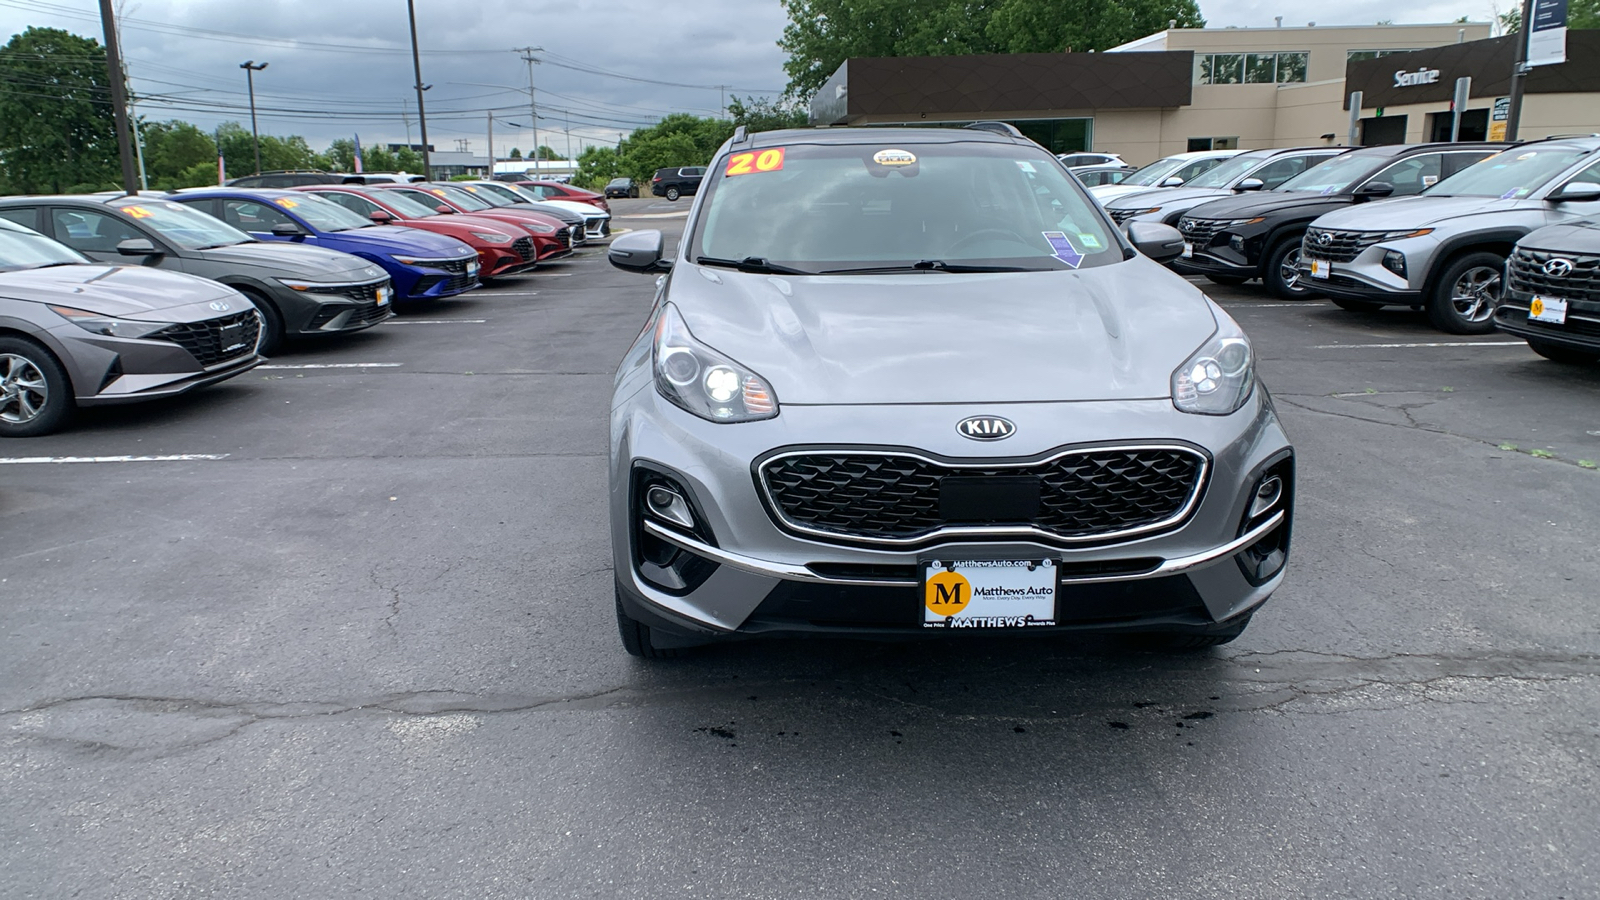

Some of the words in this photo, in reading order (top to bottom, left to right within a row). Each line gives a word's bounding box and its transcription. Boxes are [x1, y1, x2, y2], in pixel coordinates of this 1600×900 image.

[1393, 67, 1440, 88] Service
[727, 149, 782, 175] 20
[966, 419, 1008, 434] KIA
[952, 559, 1032, 568] MatthewsAuto.com
[932, 582, 964, 605] M
[973, 586, 1026, 597] Matthews
[1026, 586, 1054, 595] Auto
[950, 616, 1026, 628] MATTHEWS
